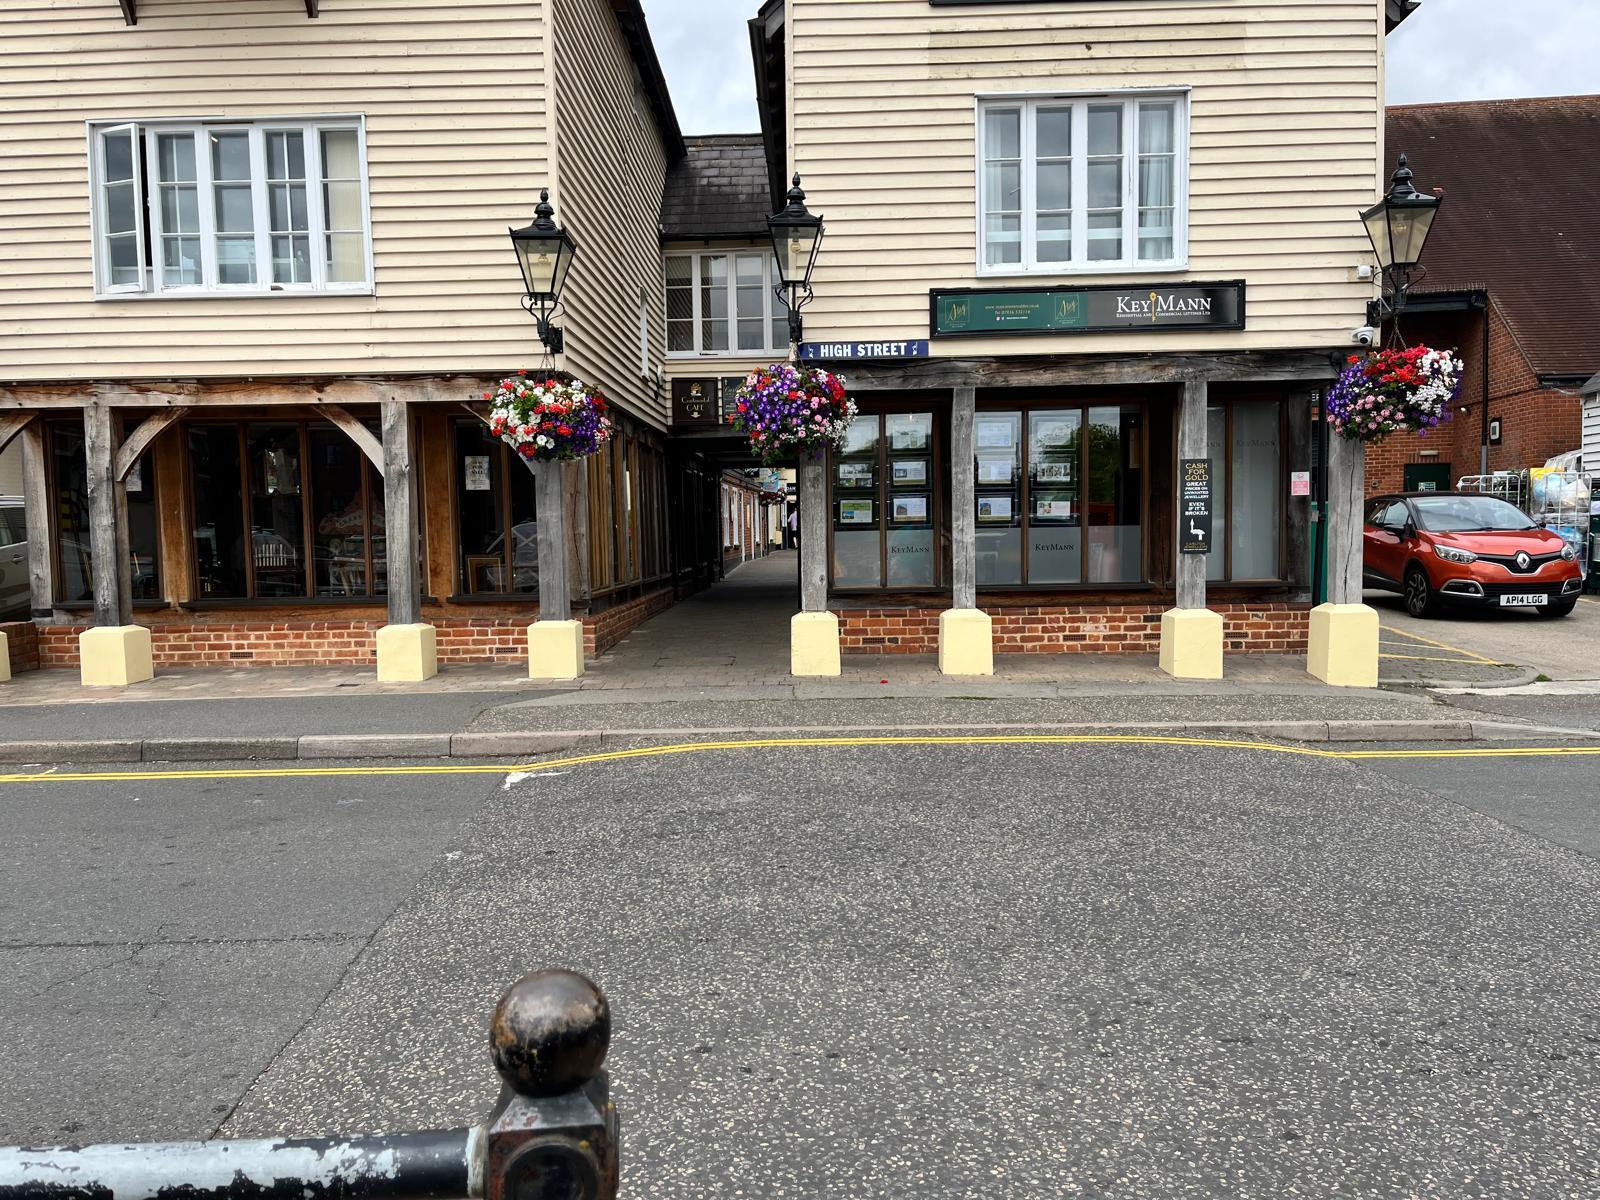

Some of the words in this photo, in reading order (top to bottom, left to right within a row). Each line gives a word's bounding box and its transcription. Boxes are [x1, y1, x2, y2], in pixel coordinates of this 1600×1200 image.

[1116, 296, 1151, 312] KEY
[1156, 295, 1212, 311] MANN
[820, 344, 851, 357] HIGH
[857, 342, 907, 356] STREET
[1035, 543, 1075, 551] KEYMANN
[1505, 595, 1524, 604] AP14
[1526, 595, 1543, 604] LGG
